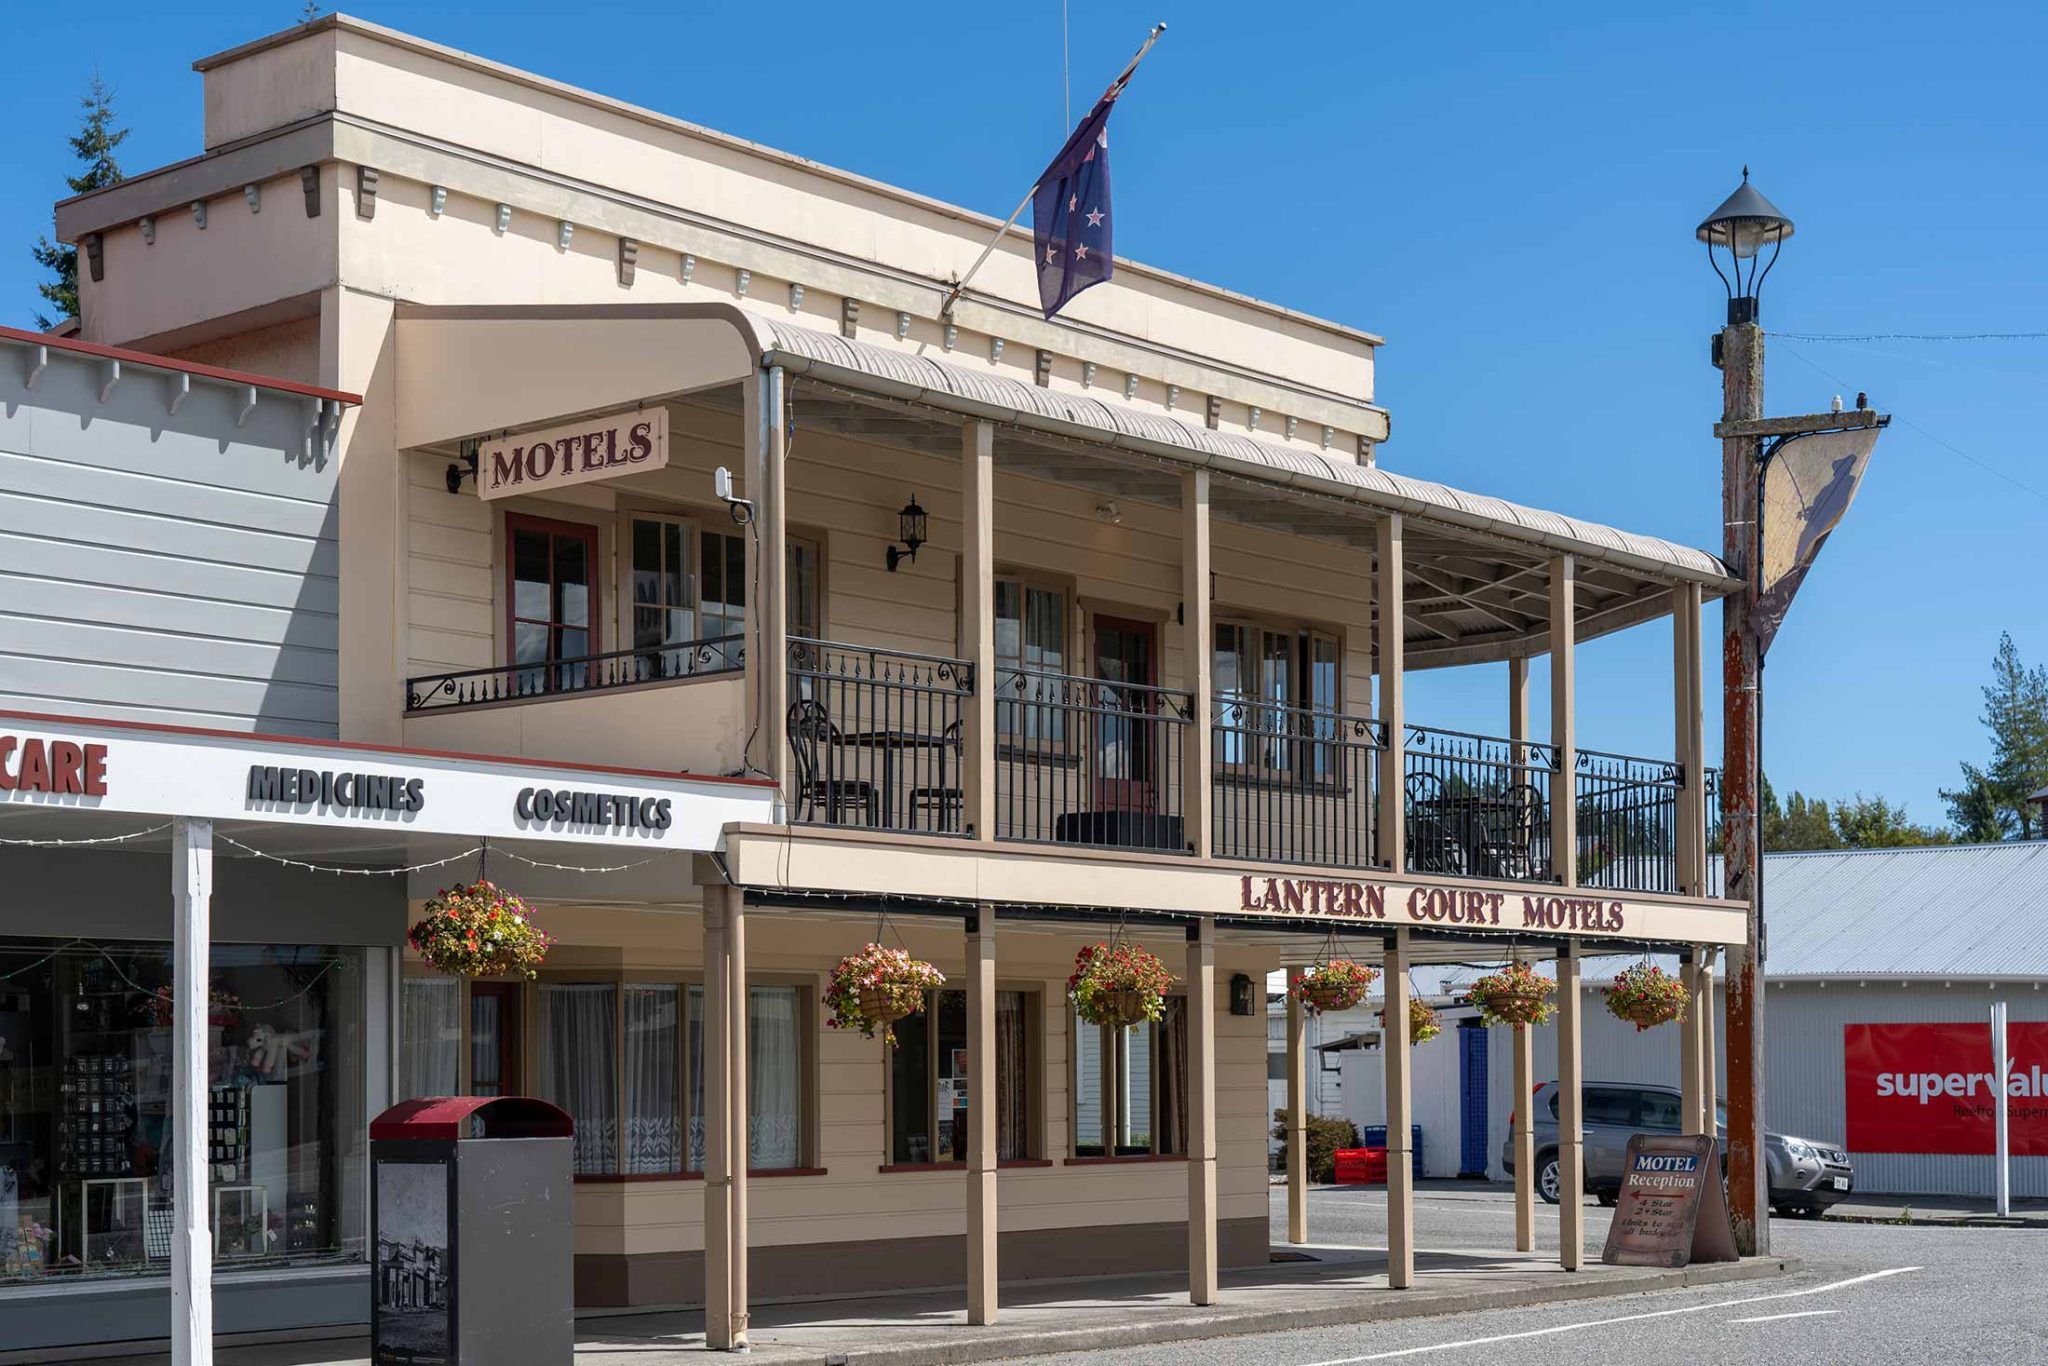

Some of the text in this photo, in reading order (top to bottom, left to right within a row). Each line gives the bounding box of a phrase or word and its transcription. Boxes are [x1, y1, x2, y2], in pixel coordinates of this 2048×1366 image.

[489, 421, 653, 489] MOTELS
[0, 735, 108, 796] CARE
[248, 764, 425, 812] MEDICINES
[516, 786, 673, 831] COSMETICS
[1240, 875, 1625, 933] LANTERN COURT MOTELS
[1876, 1057, 2048, 1104] superval
[1954, 1104, 2048, 1119] Reefto Super
[1636, 1155, 1696, 1172] MOTEL
[1628, 1173, 1696, 1191] Reception
[1650, 1208, 1674, 1217] Star
[1651, 1199, 1675, 1208] Star
[1622, 1218, 1649, 1227] Units
[1651, 1219, 1662, 1228] to
